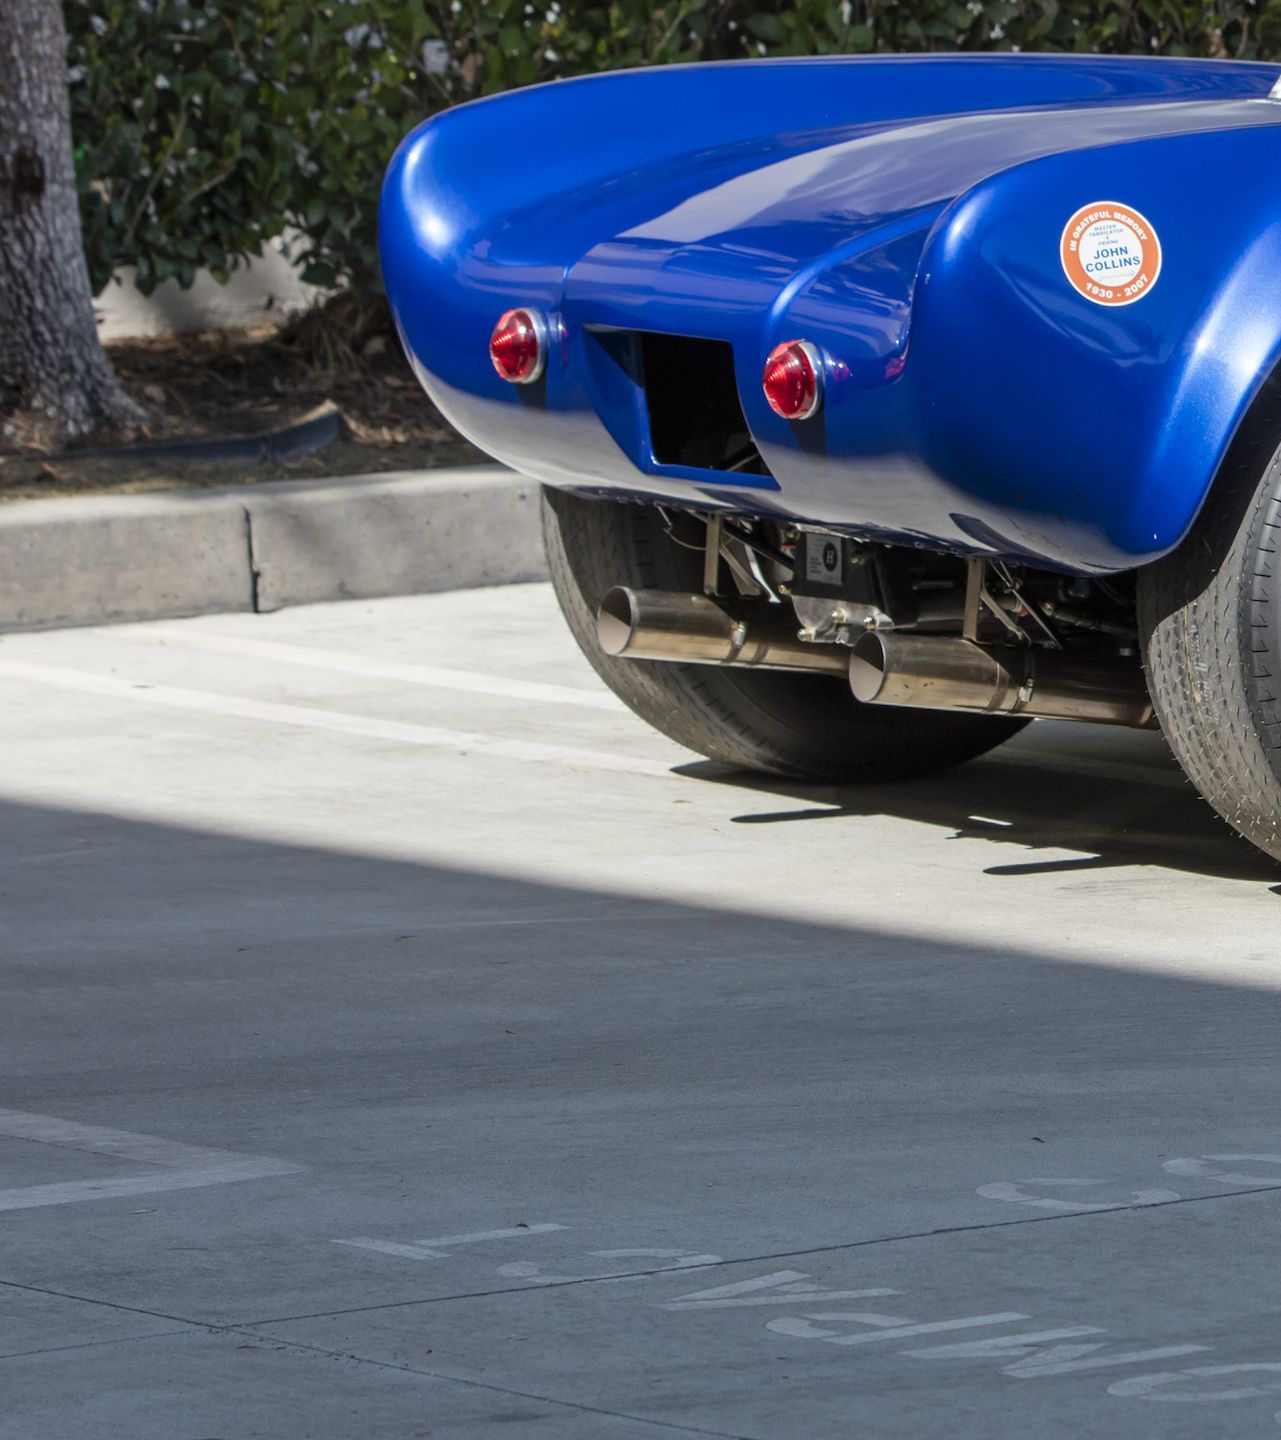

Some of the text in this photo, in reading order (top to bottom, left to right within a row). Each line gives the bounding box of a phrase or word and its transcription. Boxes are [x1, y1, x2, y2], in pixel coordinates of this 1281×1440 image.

[1070, 210, 1148, 252] IN GRATEFUL MEMORY
[1093, 246, 1128, 260] JOHN
[1085, 256, 1141, 273] COLLINS
[1086, 282, 1113, 299] 1930
[1124, 273, 1148, 297] 2007
